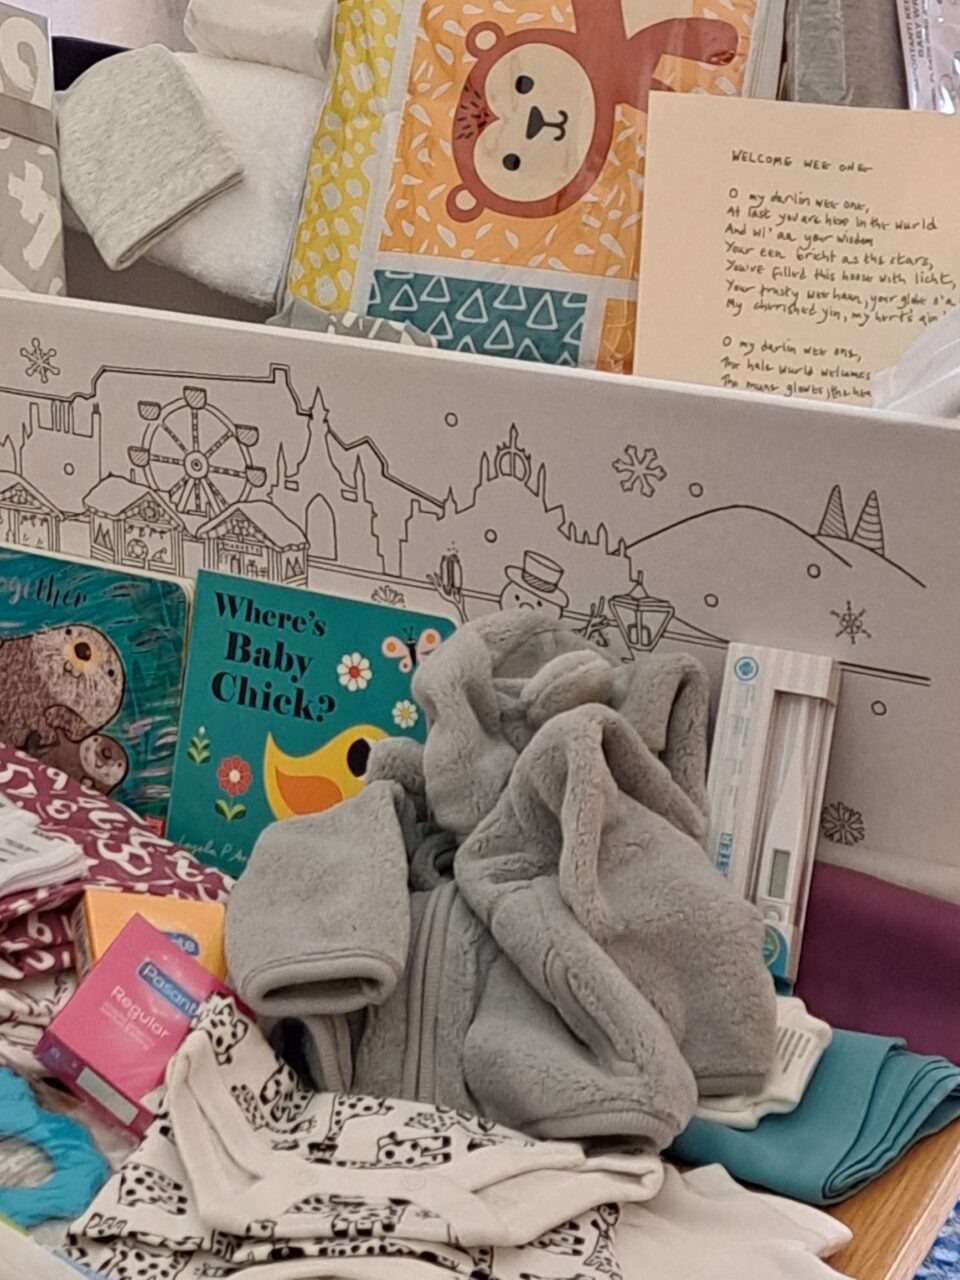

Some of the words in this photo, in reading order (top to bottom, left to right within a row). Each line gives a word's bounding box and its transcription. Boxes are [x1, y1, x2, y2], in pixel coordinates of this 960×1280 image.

[731, 149, 792, 167] WELCOME
[803, 160, 831, 171] WEE
[839, 162, 873, 173] ONE
[728, 187, 739, 199] O
[770, 190, 810, 206] darlin
[815, 198, 839, 209] wee
[726, 206, 740, 218] At
[748, 205, 771, 220] last
[775, 212, 799, 227] you
[856, 216, 867, 228] in
[870, 217, 890, 230] the
[725, 223, 747, 236] And
[804, 233, 833, 251] your
[837, 231, 873, 247] wisdom
[725, 240, 755, 255] Your
[760, 247, 786, 259] een
[842, 256, 859, 265] as
[864, 252, 886, 265] the
[890, 252, 934, 272] stars,
[726, 259, 765, 274] You've
[771, 266, 807, 281] filled
[815, 267, 836, 282] this
[879, 271, 907, 285] with
[725, 279, 756, 293] Your
[806, 289, 830, 299] wee
[870, 293, 898, 312] your
[726, 298, 743, 317] My
[753, 299, 817, 316] cherished
[851, 312, 870, 327] my
[722, 336, 732, 347] O
[740, 341, 755, 356] my
[761, 338, 797, 354] darlin
[804, 346, 827, 356] wee
[720, 355, 740, 369] The
[721, 373, 739, 387] The
[214, 591, 327, 638] Where's
[224, 630, 314, 683] Baby
[211, 671, 336, 723] Chick?
[110, 985, 171, 1039] Regular
